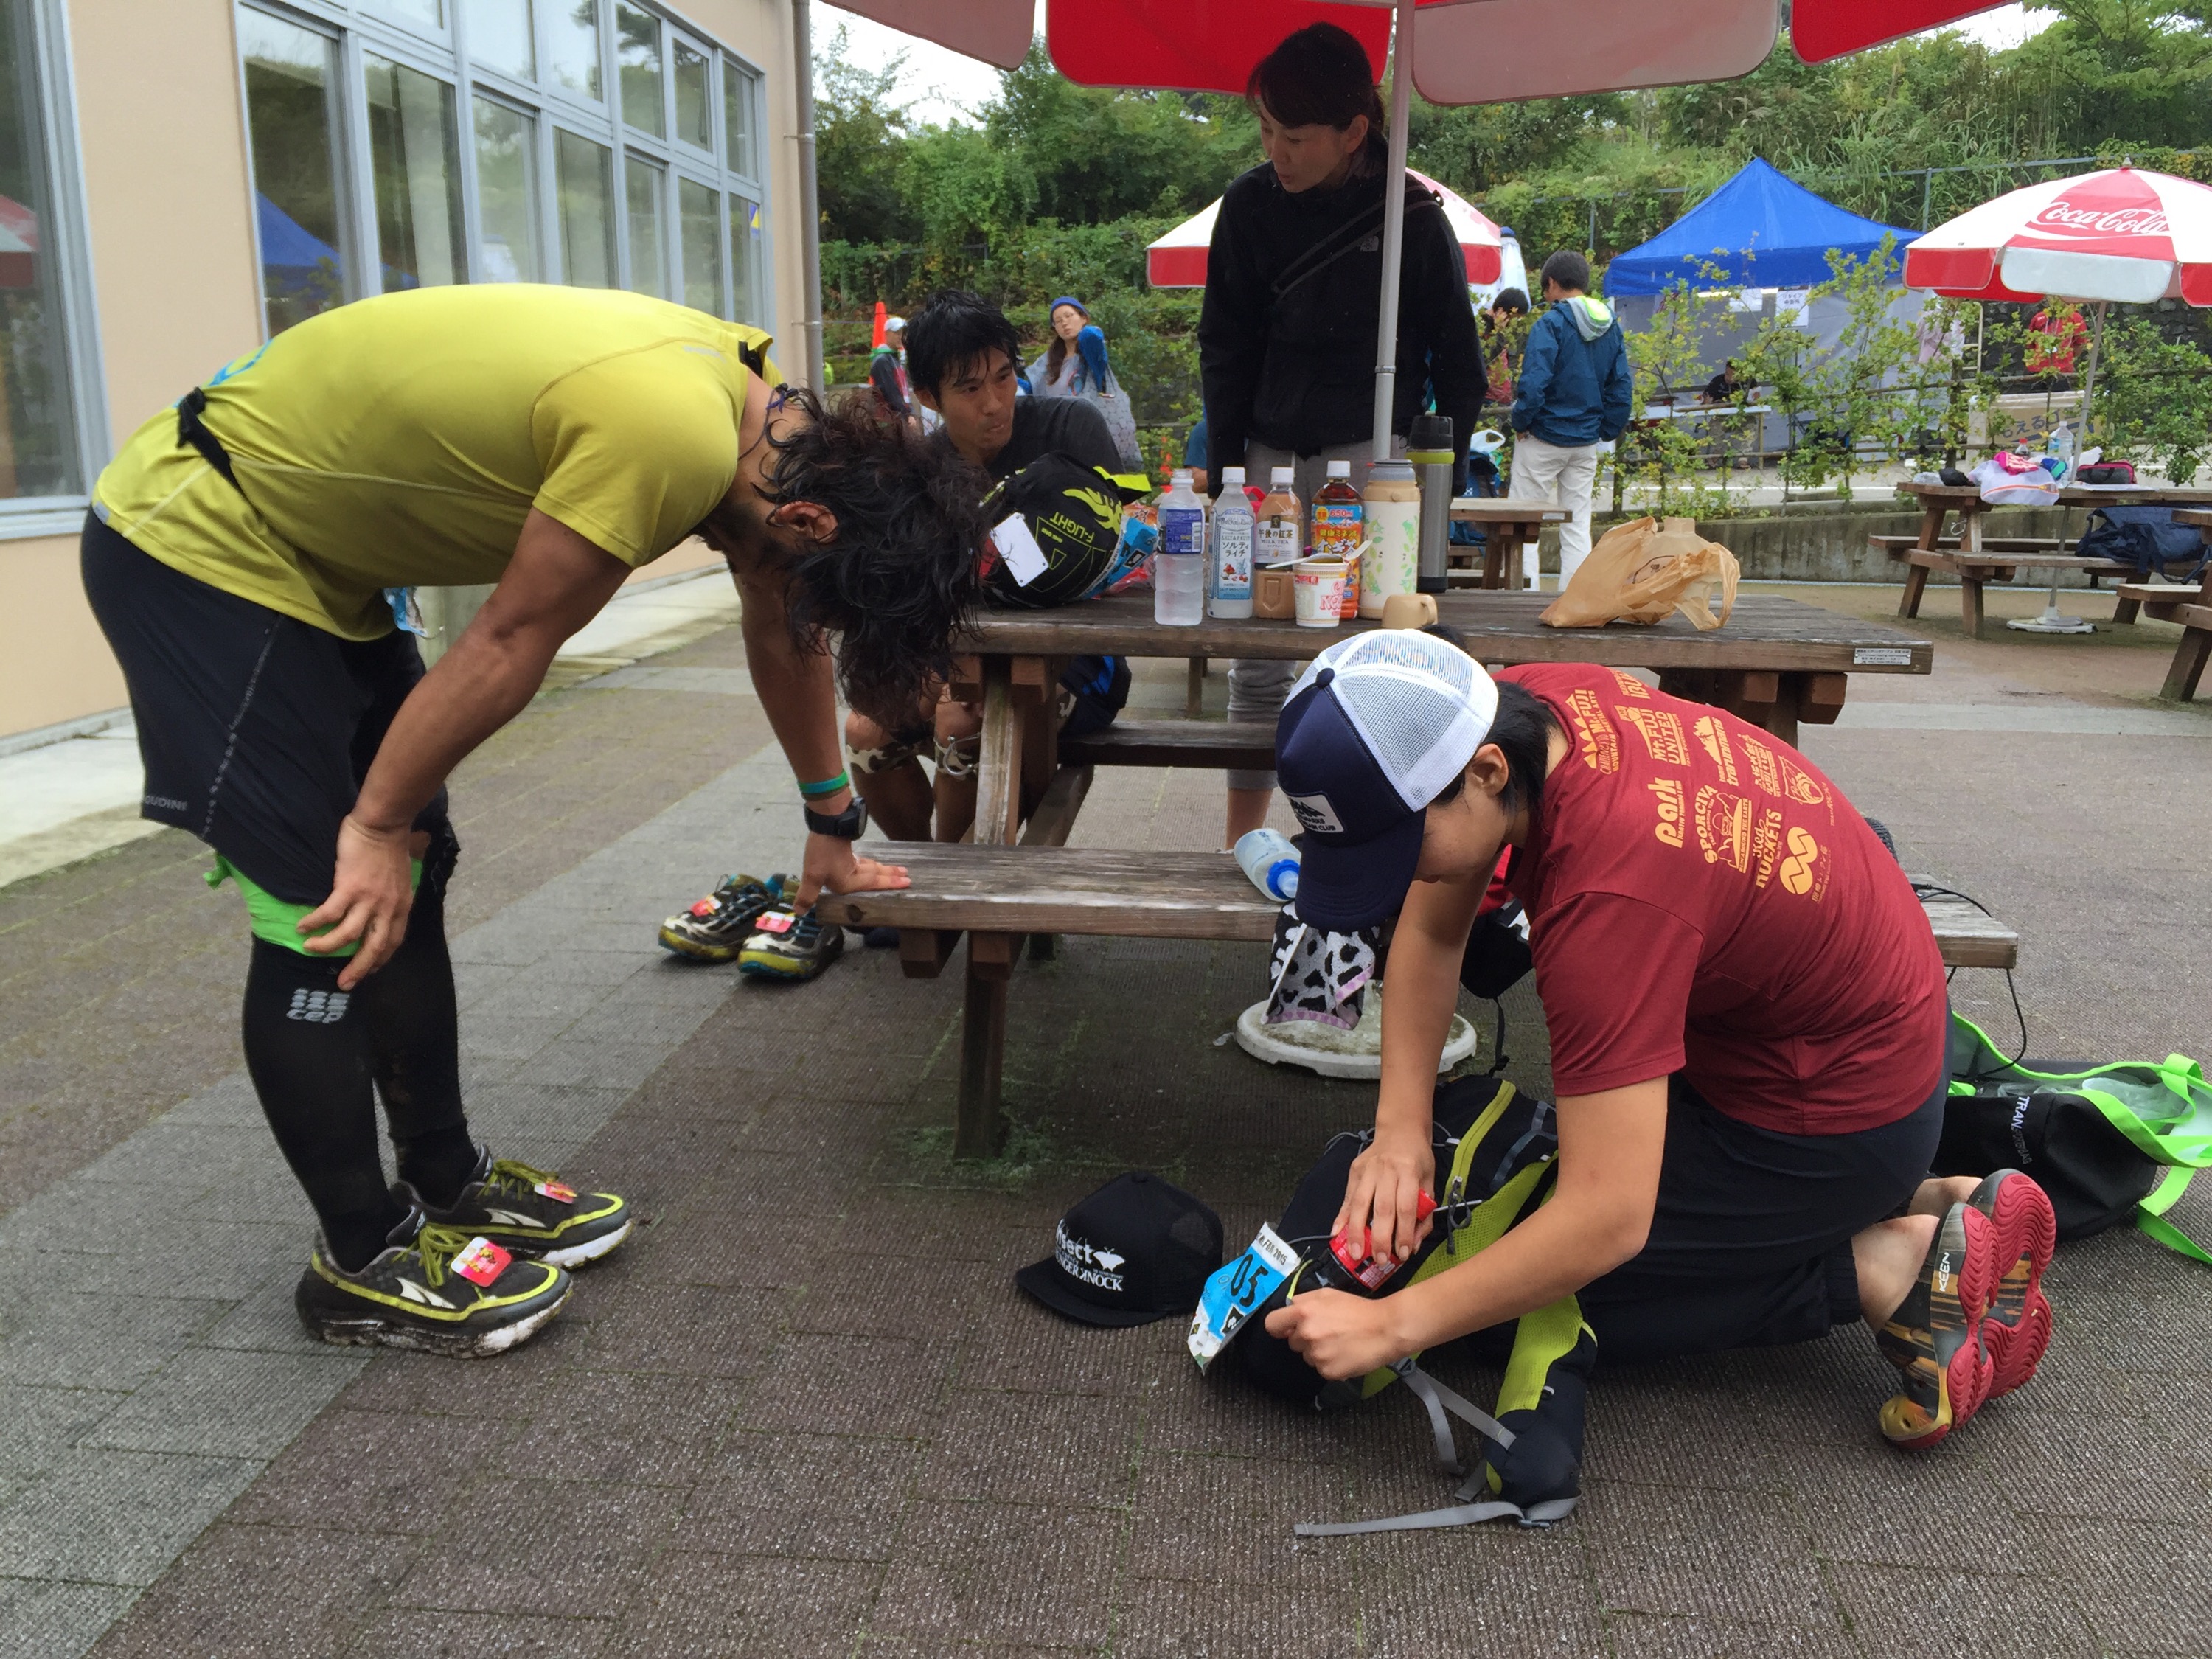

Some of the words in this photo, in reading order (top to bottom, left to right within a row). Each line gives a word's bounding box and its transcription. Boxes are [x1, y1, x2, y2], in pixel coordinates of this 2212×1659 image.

[1050, 511, 1096, 544] F-LIGHT
[1258, 529, 1294, 539] 午後の紅茶
[1225, 549, 1246, 557] ライチ
[1587, 689, 1601, 709] ARTS
[1639, 708, 1668, 762] Mt.FUJI
[1655, 710, 1680, 765] UNITED
[1694, 785, 1719, 864] SPORCIVA
[1274, 1248, 1288, 1266] 2015
[1939, 1251, 1950, 1292] KEEN
